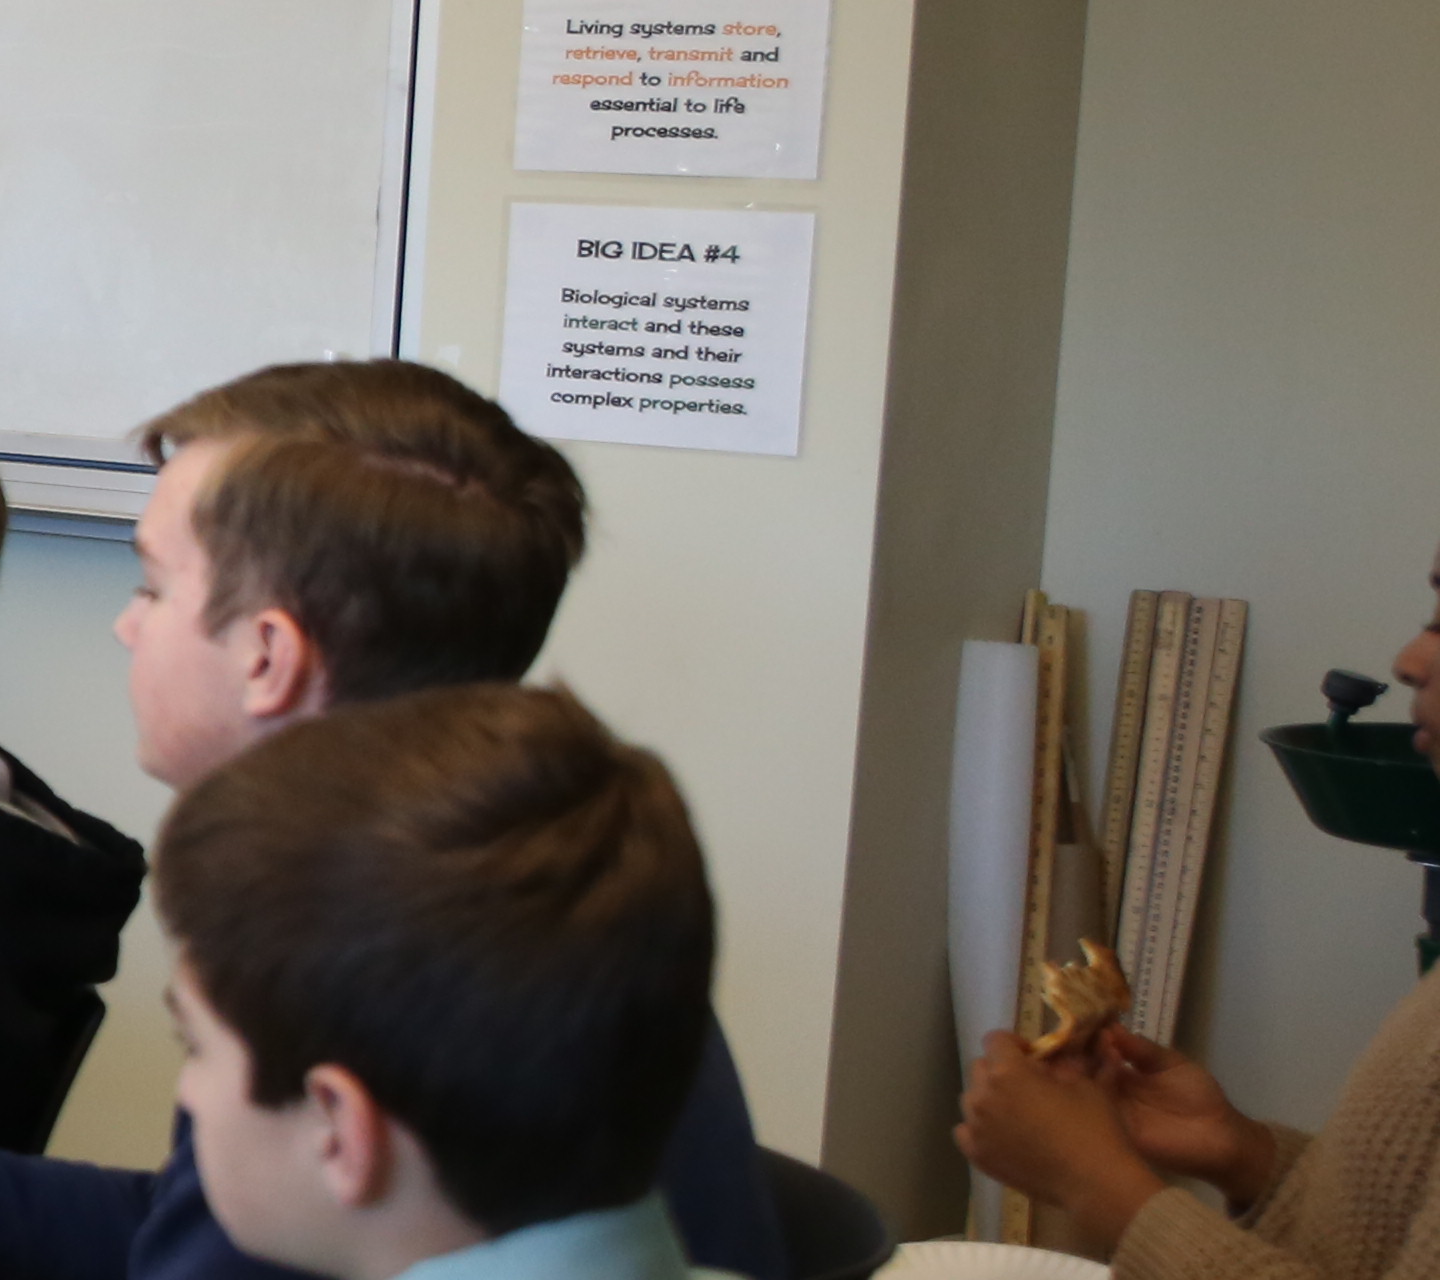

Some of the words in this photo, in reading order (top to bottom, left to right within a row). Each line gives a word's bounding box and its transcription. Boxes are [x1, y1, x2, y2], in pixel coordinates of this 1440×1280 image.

[566, 20, 623, 38] Living
[629, 21, 715, 38] systems
[722, 22, 780, 38] store,
[565, 46, 642, 63] retrieve,
[649, 48, 733, 61] transmit
[741, 47, 779, 62] and
[553, 72, 632, 88] respond
[640, 73, 660, 86] to
[668, 71, 788, 88] information
[590, 98, 678, 113] essential
[684, 100, 705, 113] to
[714, 98, 745, 114] life
[611, 125, 718, 140] processes.
[577, 240, 623, 259] BIG
[632, 242, 695, 263] IDEA
[704, 245, 740, 263] #4
[561, 288, 656, 308] Biological
[663, 294, 749, 312] systems
[563, 314, 638, 331] interact
[644, 319, 680, 334] and
[688, 321, 744, 337] these
[562, 341, 644, 358] systems
[651, 345, 688, 360] and
[695, 347, 742, 363] their
[546, 364, 662, 384] interactions
[669, 373, 755, 390] possess
[551, 391, 633, 409] complex
[639, 397, 746, 415] properties.
